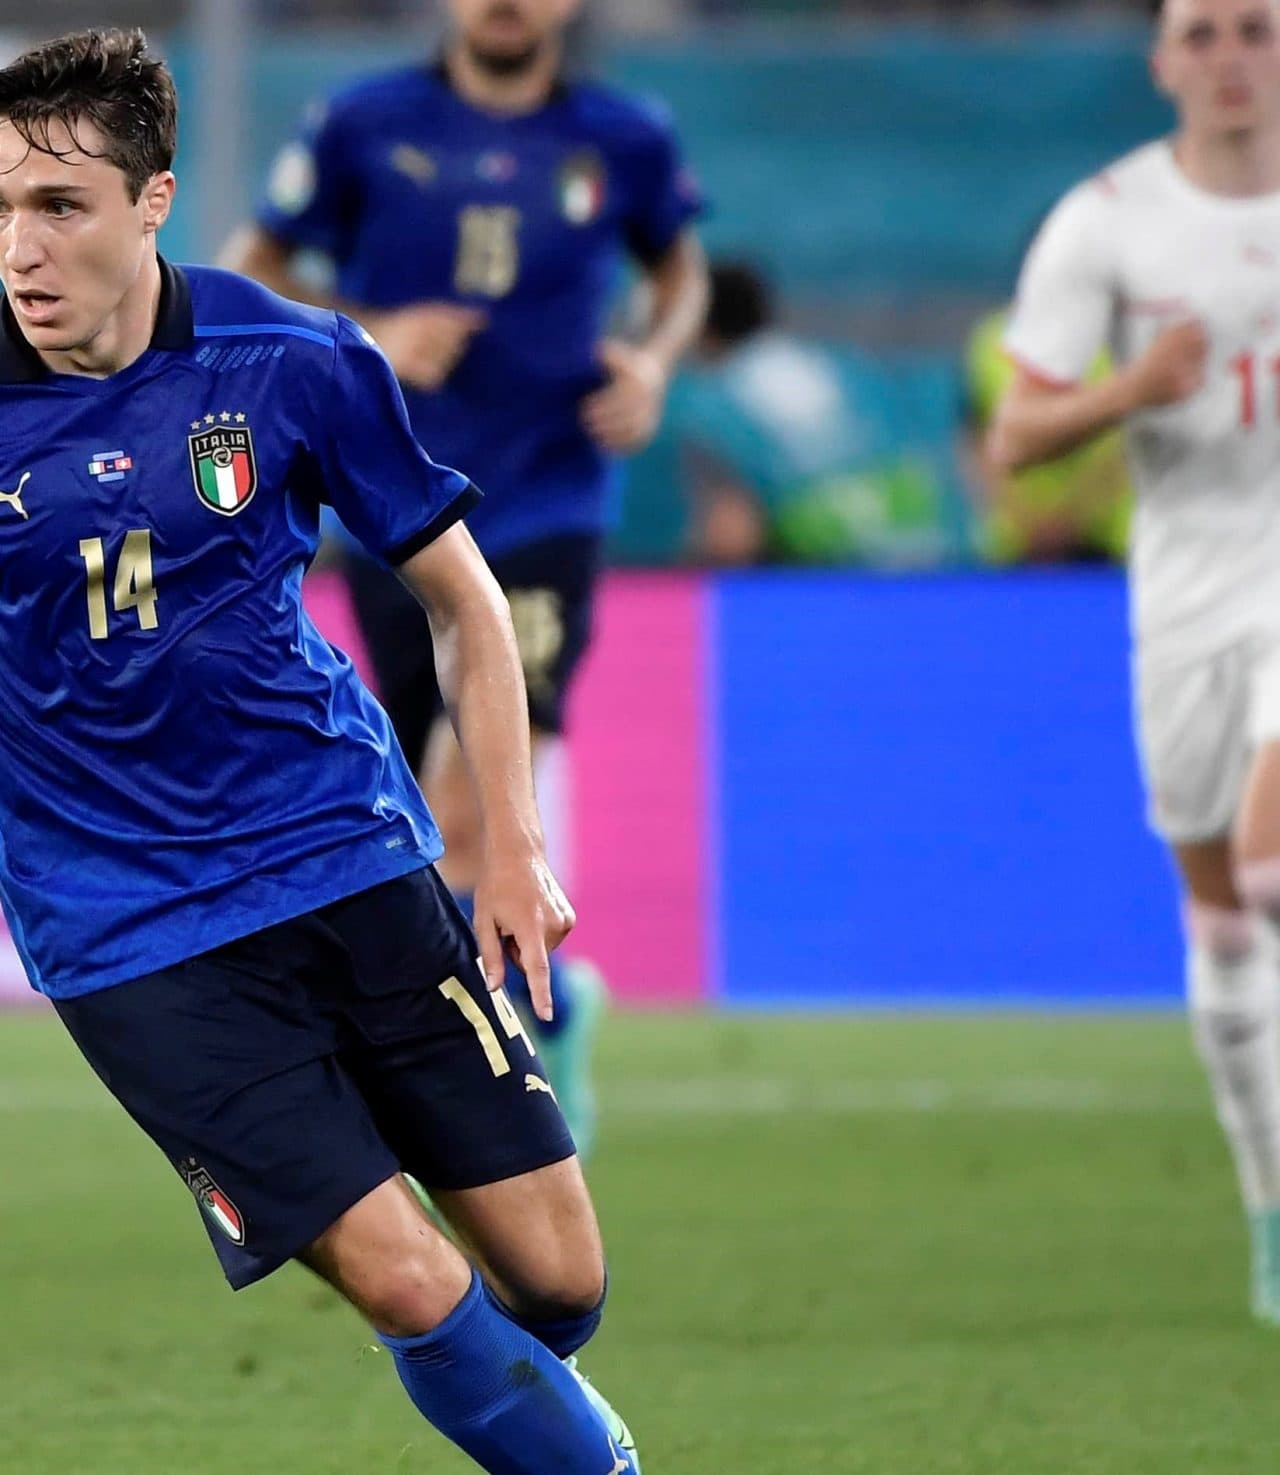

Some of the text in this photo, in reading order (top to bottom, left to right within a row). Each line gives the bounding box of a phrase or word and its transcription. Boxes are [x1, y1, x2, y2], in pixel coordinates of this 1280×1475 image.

[195, 433, 245, 452] ITALIA
[79, 529, 158, 639] 14
[438, 956, 536, 1078] 14
